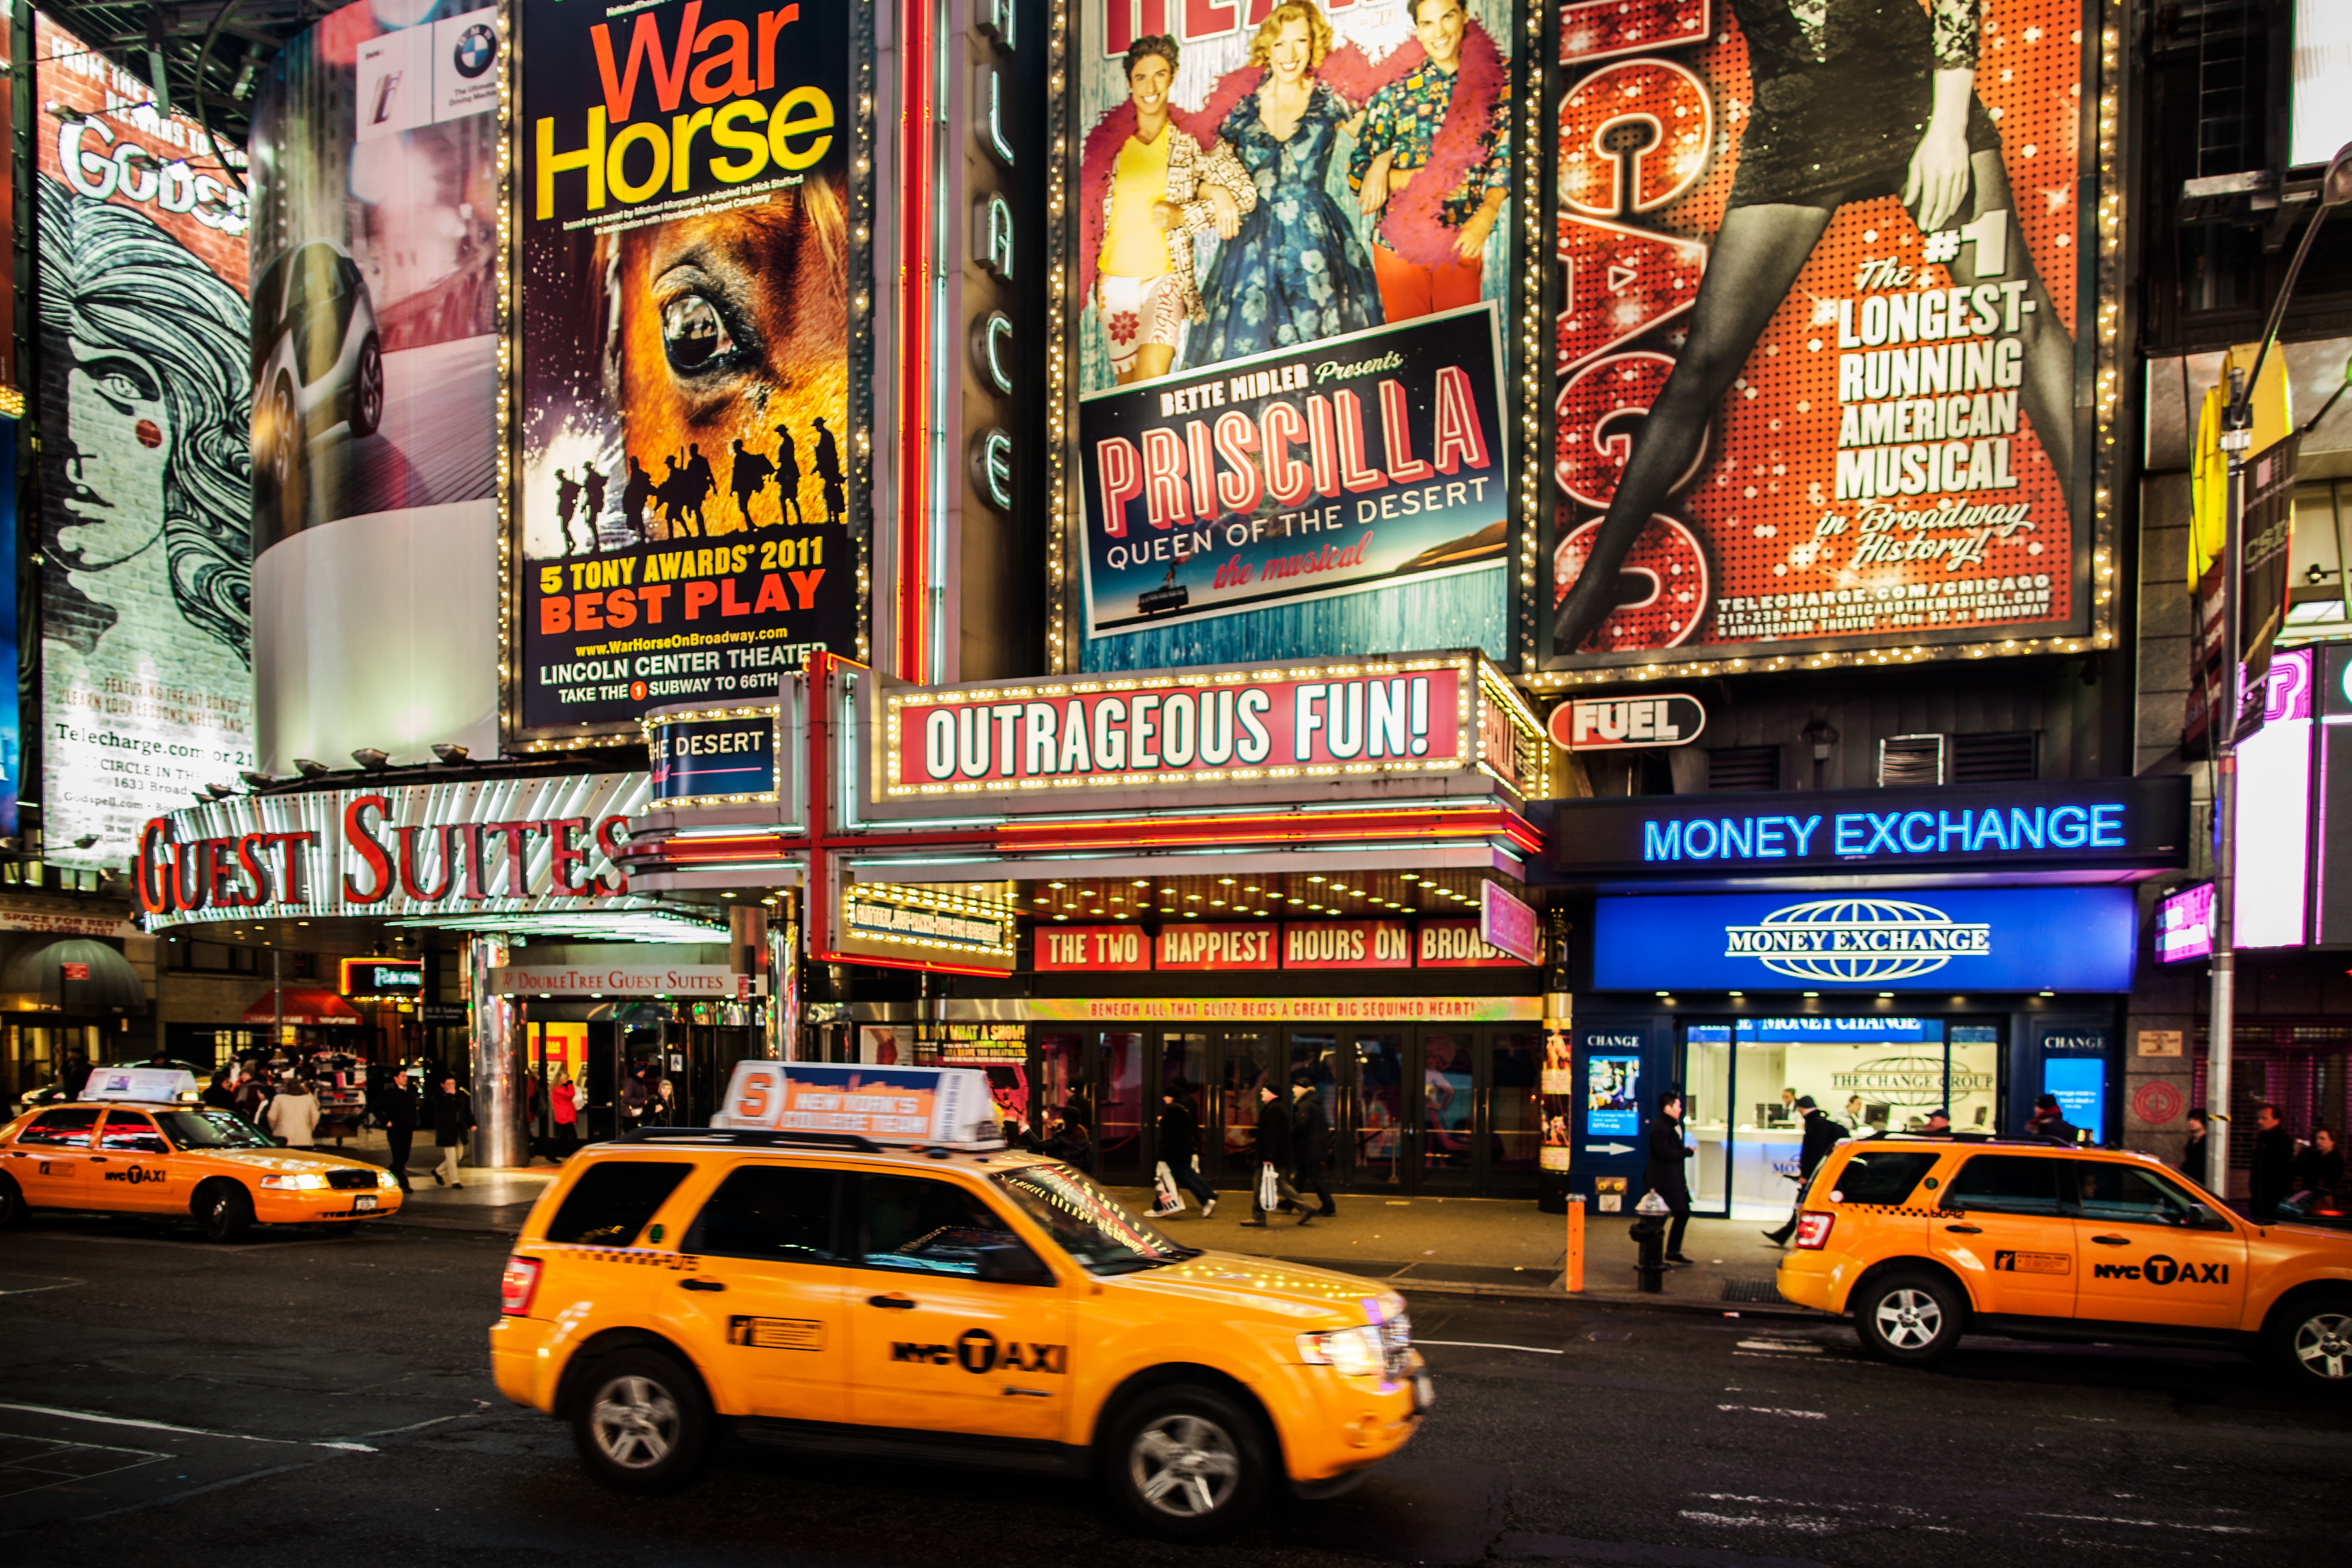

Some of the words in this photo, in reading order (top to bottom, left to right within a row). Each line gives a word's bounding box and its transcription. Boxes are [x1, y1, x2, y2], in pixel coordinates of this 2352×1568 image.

[590, 0, 799, 124] War
[536, 86, 835, 220] Horse
[752, 180, 771, 193] Nick
[1923, 210, 2008, 278] #1
[1856, 256, 1915, 291] The
[1837, 281, 2036, 349] LONGEST-
[1160, 381, 1224, 417] BETTE
[1230, 363, 1309, 404] MIDLER
[1314, 350, 1403, 385] Presents
[1837, 338, 2024, 403] RUNNING
[1837, 390, 2018, 448] AMERICAN
[1097, 365, 1491, 538] PRISCILLA
[1835, 437, 2017, 500] MUSICAL
[1107, 529, 1212, 571] QUEEN
[1226, 518, 1268, 547] OF
[1279, 506, 1344, 538] THE
[1356, 477, 1490, 524] DESERT
[1815, 510, 1848, 537] in
[1855, 498, 2036, 537] Broadway
[540, 565, 563, 595] 5
[570, 557, 637, 591] TONY
[760, 536, 823, 570] 2011
[1213, 553, 1255, 590] the
[1261, 530, 1375, 580] musical
[1853, 527, 1993, 572] History!
[540, 585, 671, 635] BEST
[685, 569, 826, 621] PLAY
[1718, 574, 2049, 612] TELECHARGE.COM/CHICAGO
[1729, 620, 1813, 637] AMBASSADOR
[1821, 616, 1876, 631] THEATRE
[1976, 603, 2050, 619] BROADWAY
[576, 627, 788, 657] www.WarHorseOnBroadway.com
[540, 658, 630, 686] LINCOLN
[635, 649, 720, 677] CENTER
[559, 687, 597, 704] TAKE
[599, 683, 629, 700] THE
[649, 679, 711, 696] SUBWAY
[715, 676, 735, 690] TO
[740, 672, 778, 688] 66TH
[925, 687, 1272, 780] OUTRAGEOUS
[1294, 677, 1430, 762] FUN!
[1573, 701, 1679, 742] FUEL
[675, 731, 765, 757] DESERT
[100, 758, 151, 776] CIRCLE
[156, 767, 170, 778] IN
[114, 777, 144, 790] 1633
[1644, 814, 1823, 863] MONEY
[1834, 804, 2126, 856] EXCHANGE
[136, 818, 320, 915] GUEST
[343, 795, 630, 904] SUITES
[2, 912, 50, 924] SPACE
[55, 916, 83, 926] FOR
[88, 919, 123, 928] RENT
[1049, 933, 1087, 965] THE
[1095, 932, 1140, 964] TWO
[1164, 930, 1271, 963] HAPPIEST
[1289, 929, 1367, 962] HOURS
[1375, 928, 1407, 960] ON
[1726, 930, 1828, 952] MONEY
[1833, 928, 1991, 952] EXCHANGE
[608, 970, 662, 989] GUEST
[667, 970, 724, 989] SUITES
[1145, 1002, 1165, 1017] ALL
[1170, 1002, 1198, 1017] THAT
[1203, 1002, 1237, 1017] GLITZ
[1242, 1002, 1277, 1017] BEATS
[1282, 1002, 1289, 1017] A
[1294, 1002, 1331, 1017] GREAT
[1336, 1002, 1357, 1017] BIG
[1363, 1002, 1424, 1018] SEQUINED
[1587, 1035, 1640, 1048] CHANGE
[2044, 1036, 2105, 1049] CHANGE
[1831, 1074, 1863, 1088] THE
[1866, 1074, 1933, 1088] CHANGE
[105, 1172, 126, 1181] NYC
[127, 1164, 165, 1185] TAXI
[2094, 1264, 2141, 1279] NYC
[2143, 1254, 2229, 1285] TAXI
[957, 1328, 1067, 1374] TAXI
